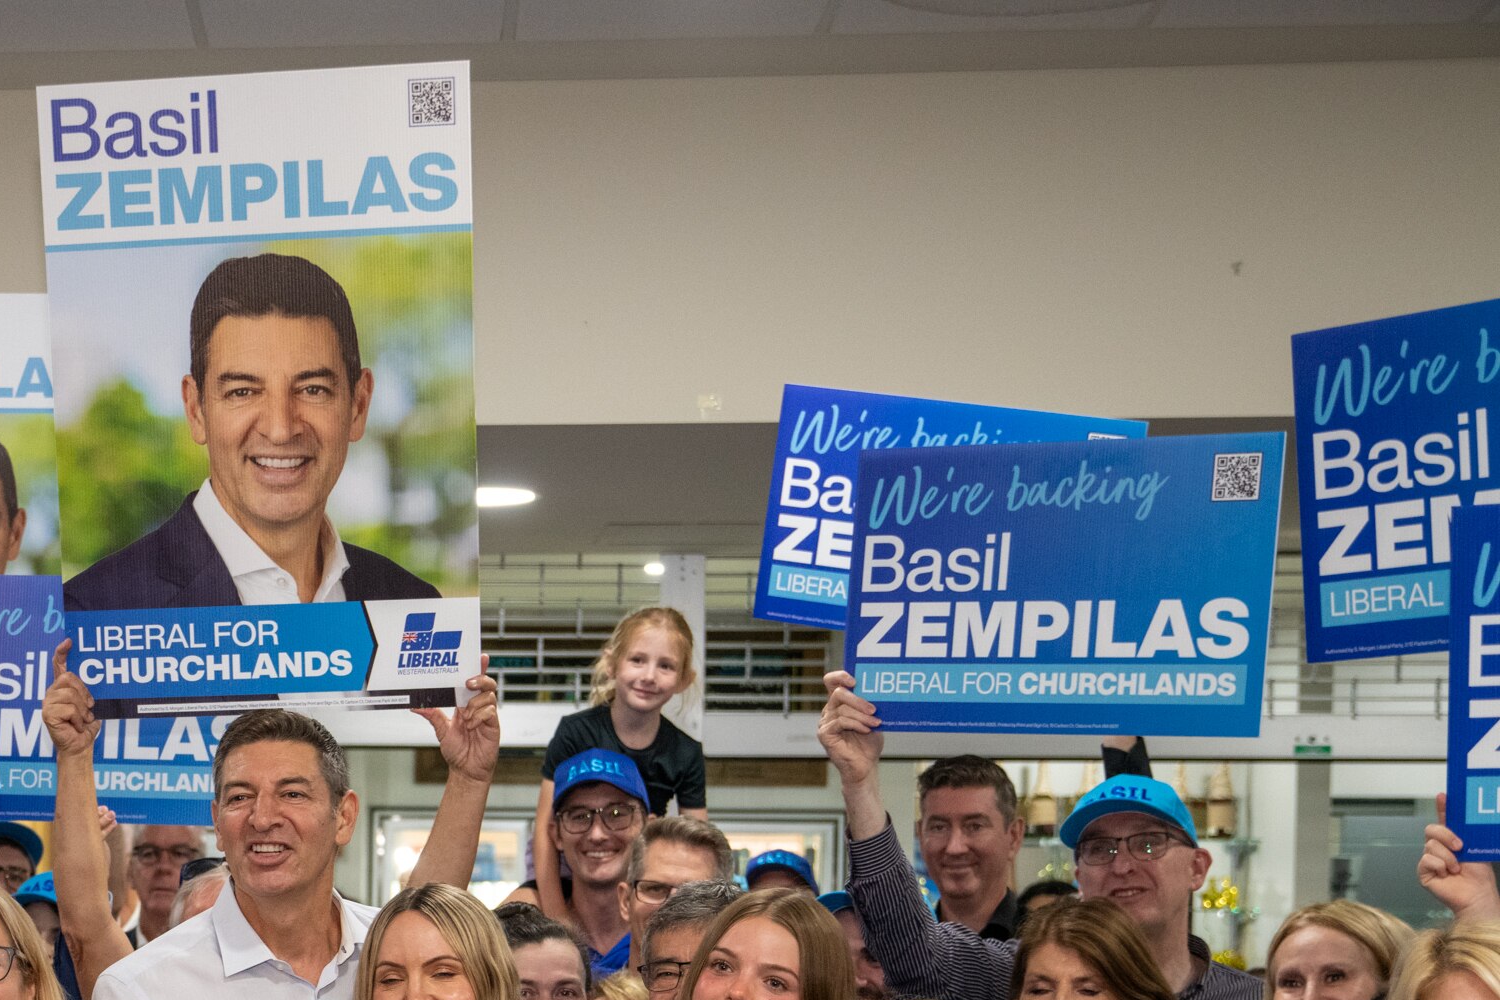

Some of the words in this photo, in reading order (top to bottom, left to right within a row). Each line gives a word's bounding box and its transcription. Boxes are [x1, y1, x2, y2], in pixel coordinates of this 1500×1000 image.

[50, 90, 218, 163] Basil
[55, 152, 459, 231] ZEMPILAS
[1314, 340, 1460, 425] We're
[790, 405, 900, 454] We're
[1312, 407, 1490, 501] Basil
[869, 466, 993, 529] We're
[1006, 460, 1169, 520] backing
[861, 532, 1011, 593] Basil
[776, 572, 846, 599] LIBERA
[1329, 581, 1444, 617] LIBERAL
[78, 622, 209, 652] LIBERAL
[214, 620, 279, 646] FOR
[856, 597, 1251, 659] ZEMPILAS
[78, 649, 353, 685] CHURCHLANDS
[398, 652, 459, 668] LIBERAL
[861, 671, 956, 694] LIBERAL
[962, 672, 1012, 695] FOR
[1017, 672, 1237, 697] CHURCHLANDS
[9, 769, 52, 789] FOR
[95, 771, 214, 793] URCHLAN
[567, 758, 624, 782] BASIL
[1086, 785, 1150, 801] SIL
